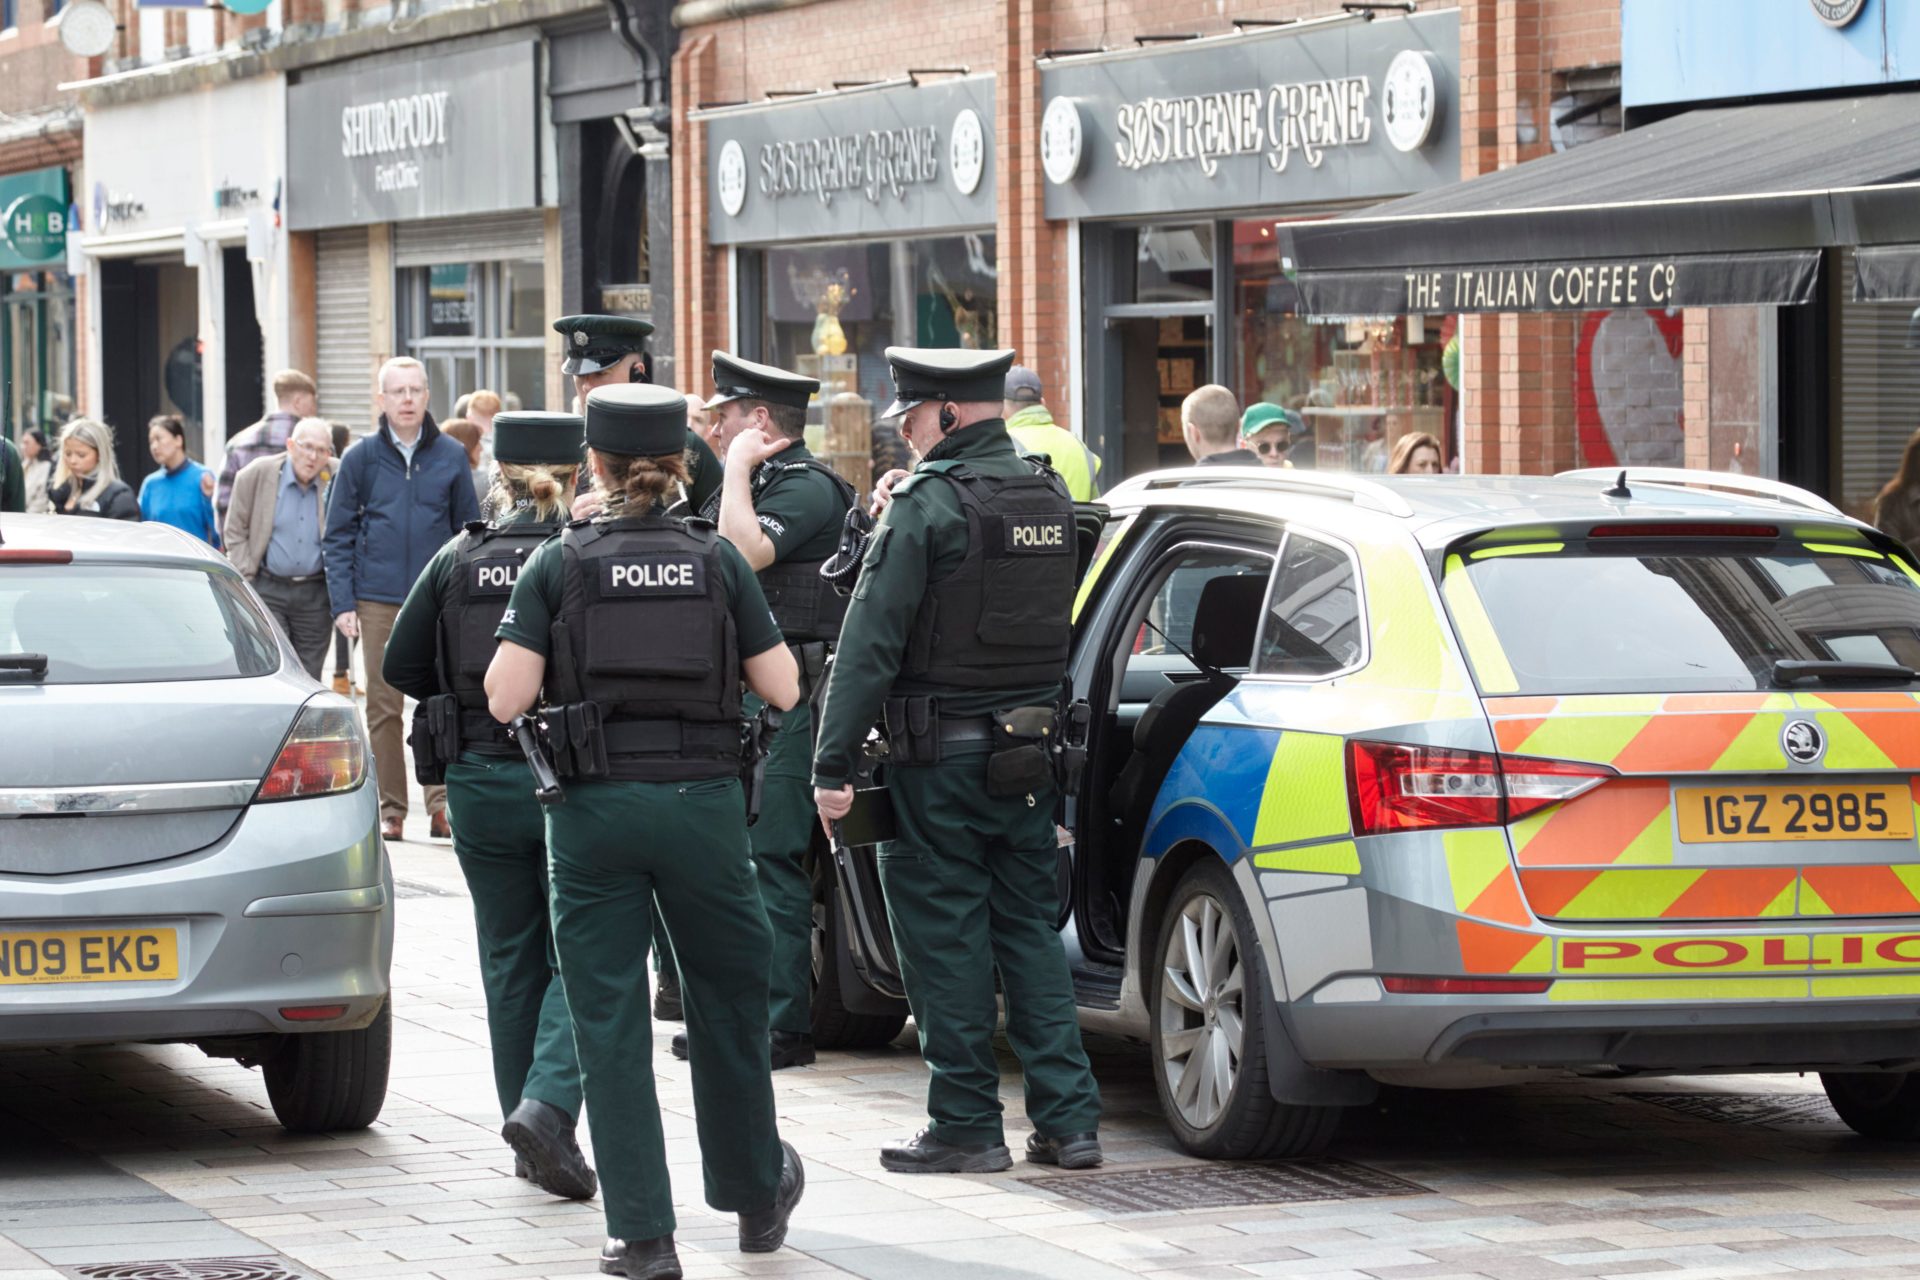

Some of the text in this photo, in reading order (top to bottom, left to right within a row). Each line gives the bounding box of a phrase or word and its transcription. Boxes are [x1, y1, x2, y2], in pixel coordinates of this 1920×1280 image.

[342, 91, 448, 157] SHUROPODY
[1266, 75, 1371, 174] GRENE
[865, 124, 937, 204] GRENE
[1405, 272, 1442, 308] THE
[1454, 270, 1537, 307] ITALIAN
[1550, 265, 1638, 305] COFFEE
[1013, 525, 1063, 546] POLICE
[611, 564, 694, 587] POLICE
[1703, 792, 1888, 836] IGZ 2985
[80, 935, 161, 974] EKG
